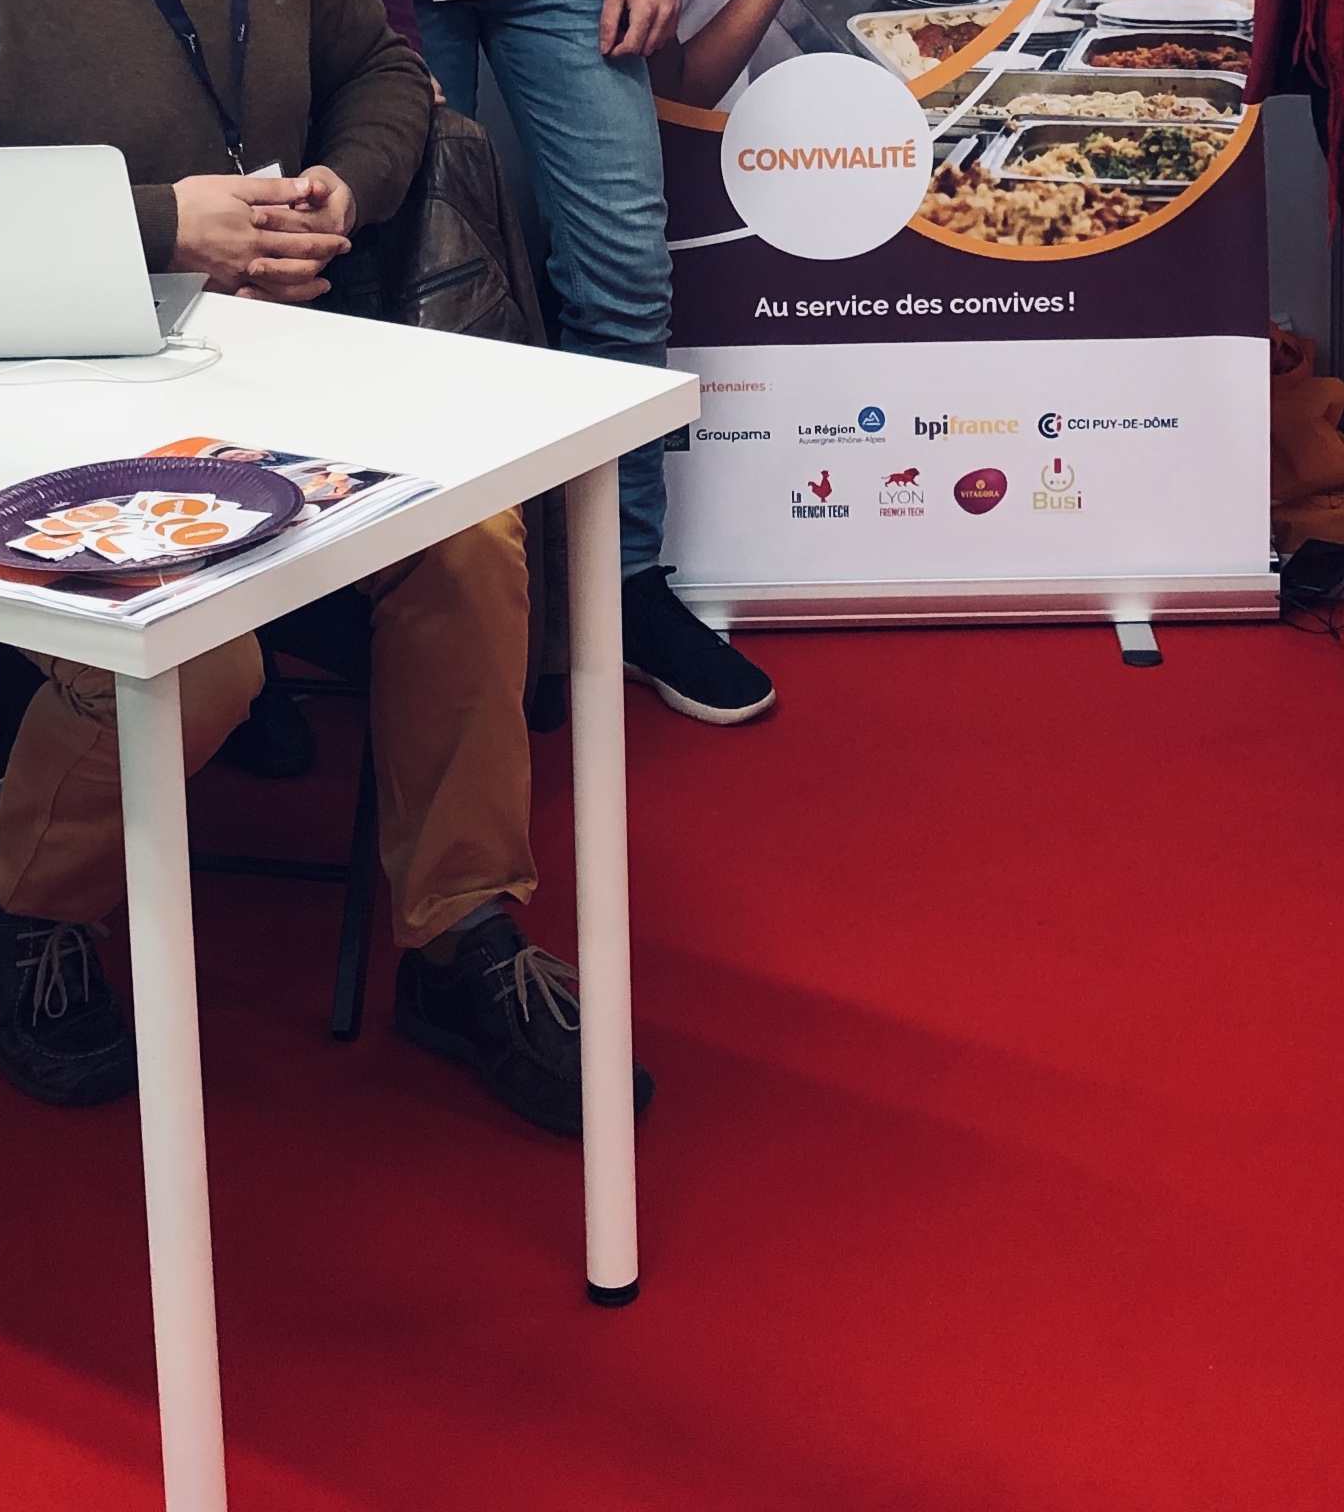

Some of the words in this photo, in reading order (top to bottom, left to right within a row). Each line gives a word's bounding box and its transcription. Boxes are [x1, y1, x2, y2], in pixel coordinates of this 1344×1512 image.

[738, 138, 916, 172] CONVIVIALITÉ
[754, 296, 788, 317] Au
[795, 295, 889, 317] service
[895, 293, 943, 315] des
[699, 381, 765, 393] artenaires
[798, 425, 811, 435] La
[814, 424, 856, 436] Région
[914, 414, 1020, 441] bpifrance
[1067, 418, 1090, 430] CCI
[1093, 416, 1179, 430] PUY-DE-DÔME
[696, 428, 771, 442] Groupama
[878, 490, 924, 505] LYON
[960, 490, 1000, 499] VITAGORA
[1032, 491, 1082, 510] Busi
[791, 505, 826, 518] FRENCH
[827, 504, 849, 518] TECH
[879, 508, 906, 517] FRENCH
[907, 507, 924, 516] TECH
